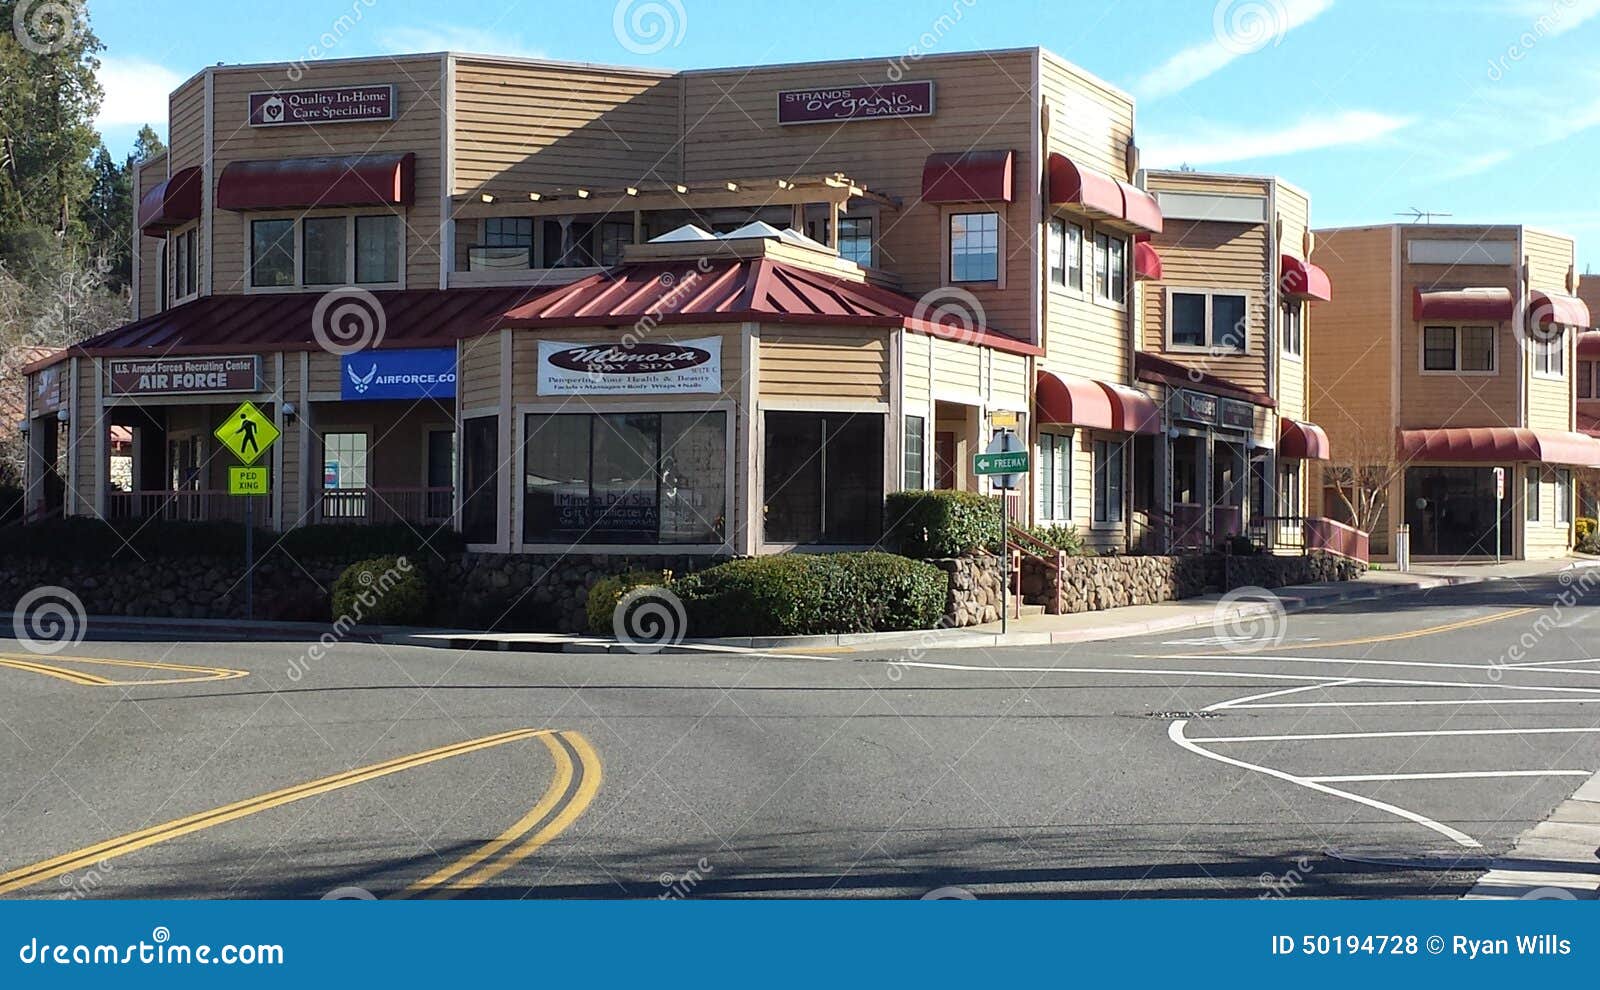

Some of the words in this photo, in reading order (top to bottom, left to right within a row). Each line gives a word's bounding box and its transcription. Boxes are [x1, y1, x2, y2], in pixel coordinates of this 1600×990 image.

[289, 94, 334, 106] Quality
[337, 92, 387, 103] In-Home
[785, 90, 851, 102] STRANDS
[806, 92, 911, 118] organic
[866, 105, 923, 115] SALON
[293, 107, 321, 118] Care
[323, 105, 382, 119] Specialists
[569, 347, 698, 363] Mimosa
[114, 363, 129, 374] U.S.
[131, 363, 156, 373] Armed
[157, 362, 183, 372] Forces
[184, 361, 224, 373] Recruiting
[225, 360, 251, 371] Center
[639, 362, 675, 370] SPA
[139, 374, 169, 389] AIR
[172, 372, 228, 388] FORCE
[375, 373, 456, 384] AIRFORCE.CO
[993, 457, 1026, 468] FREEWAY
[240, 472, 257, 480] PED
[239, 481, 259, 490] XING
